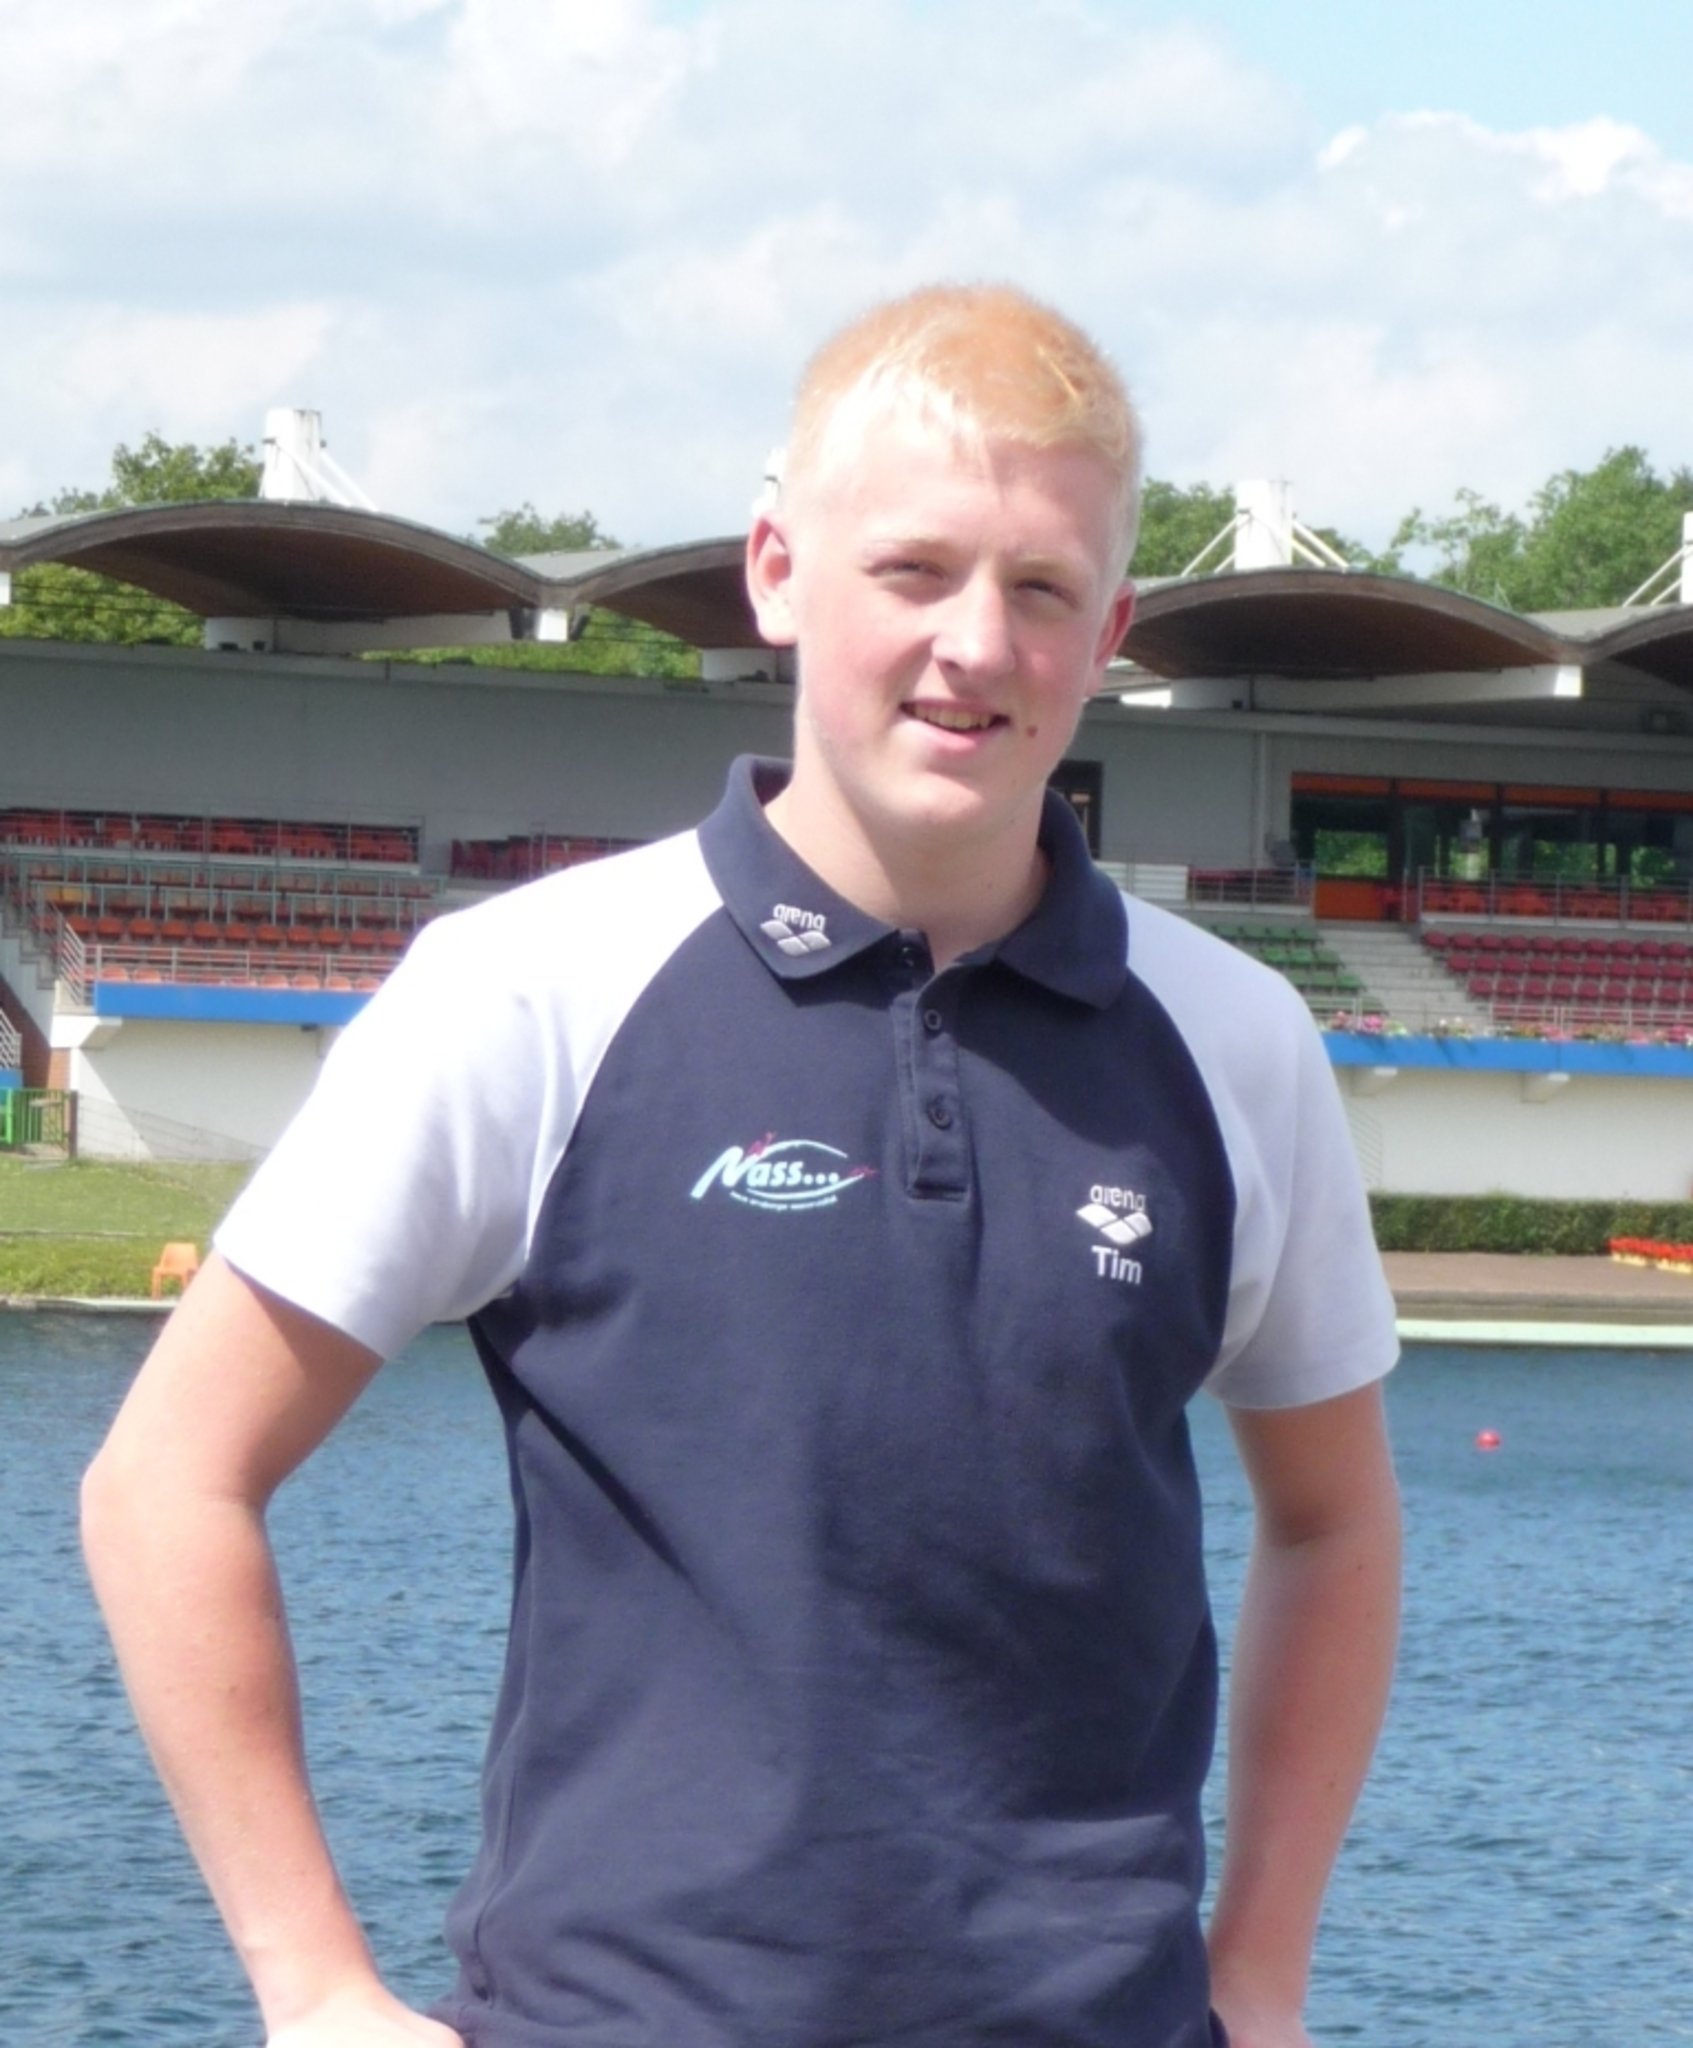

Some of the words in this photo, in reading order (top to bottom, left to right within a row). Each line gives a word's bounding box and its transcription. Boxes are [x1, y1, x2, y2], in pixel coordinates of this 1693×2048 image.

[773, 903, 826, 932] arena
[1090, 1184, 1146, 1212] arena
[1091, 1245, 1142, 1284] Tim
